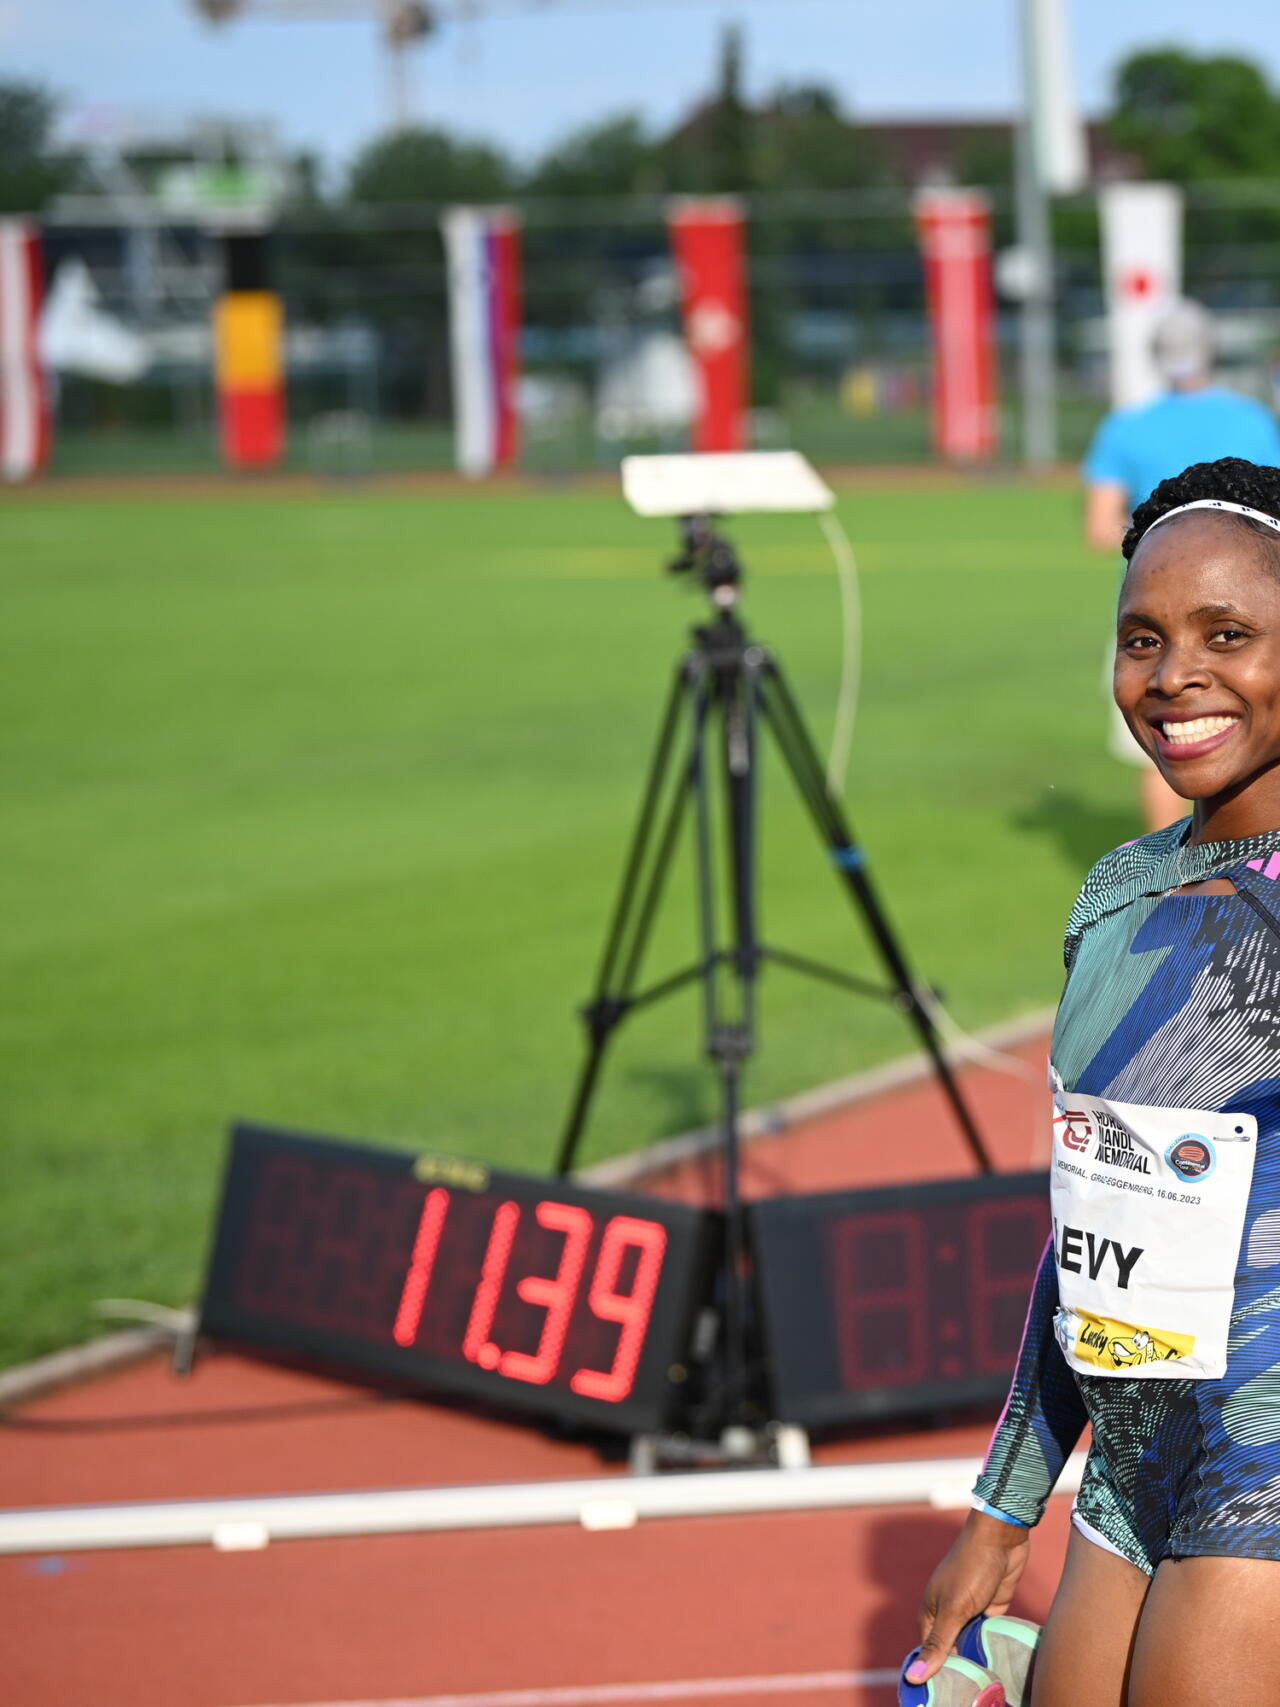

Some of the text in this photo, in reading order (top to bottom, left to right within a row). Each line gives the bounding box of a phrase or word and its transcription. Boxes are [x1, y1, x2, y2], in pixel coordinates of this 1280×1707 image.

[1157, 1189, 1201, 1205] 16.06.2023
[394, 1187, 668, 1403] 11.39
[1079, 1323, 1109, 1356] Lucky
